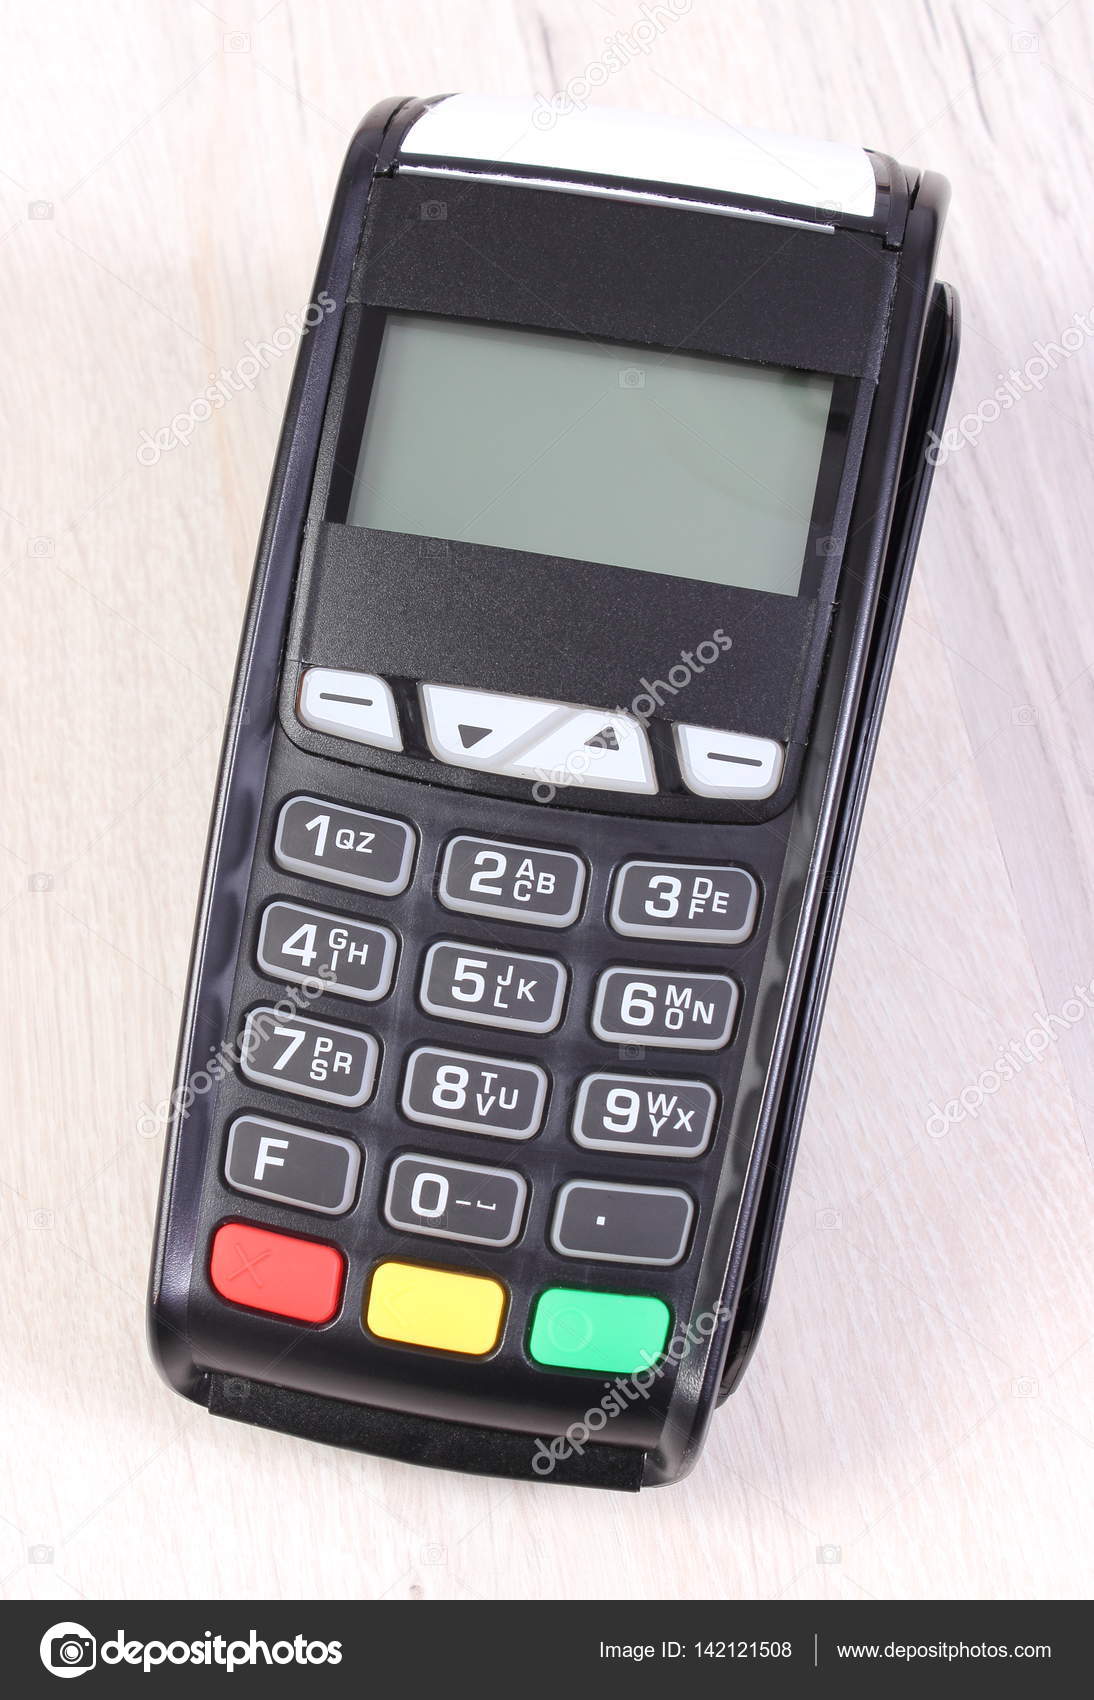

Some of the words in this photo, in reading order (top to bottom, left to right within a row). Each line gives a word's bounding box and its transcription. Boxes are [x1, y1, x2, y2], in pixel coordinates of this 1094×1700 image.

[304, 814, 331, 857] 1
[469, 850, 507, 896] 2
[644, 875, 682, 919] 3
[281, 923, 318, 967] 4
[451, 957, 488, 1003] 5
[620, 981, 657, 1027] 6
[272, 1025, 306, 1071] 7
[431, 1065, 469, 1110] 8
[602, 1088, 641, 1134] 9
[253, 1136, 289, 1181] F
[410, 1172, 450, 1218] 0
